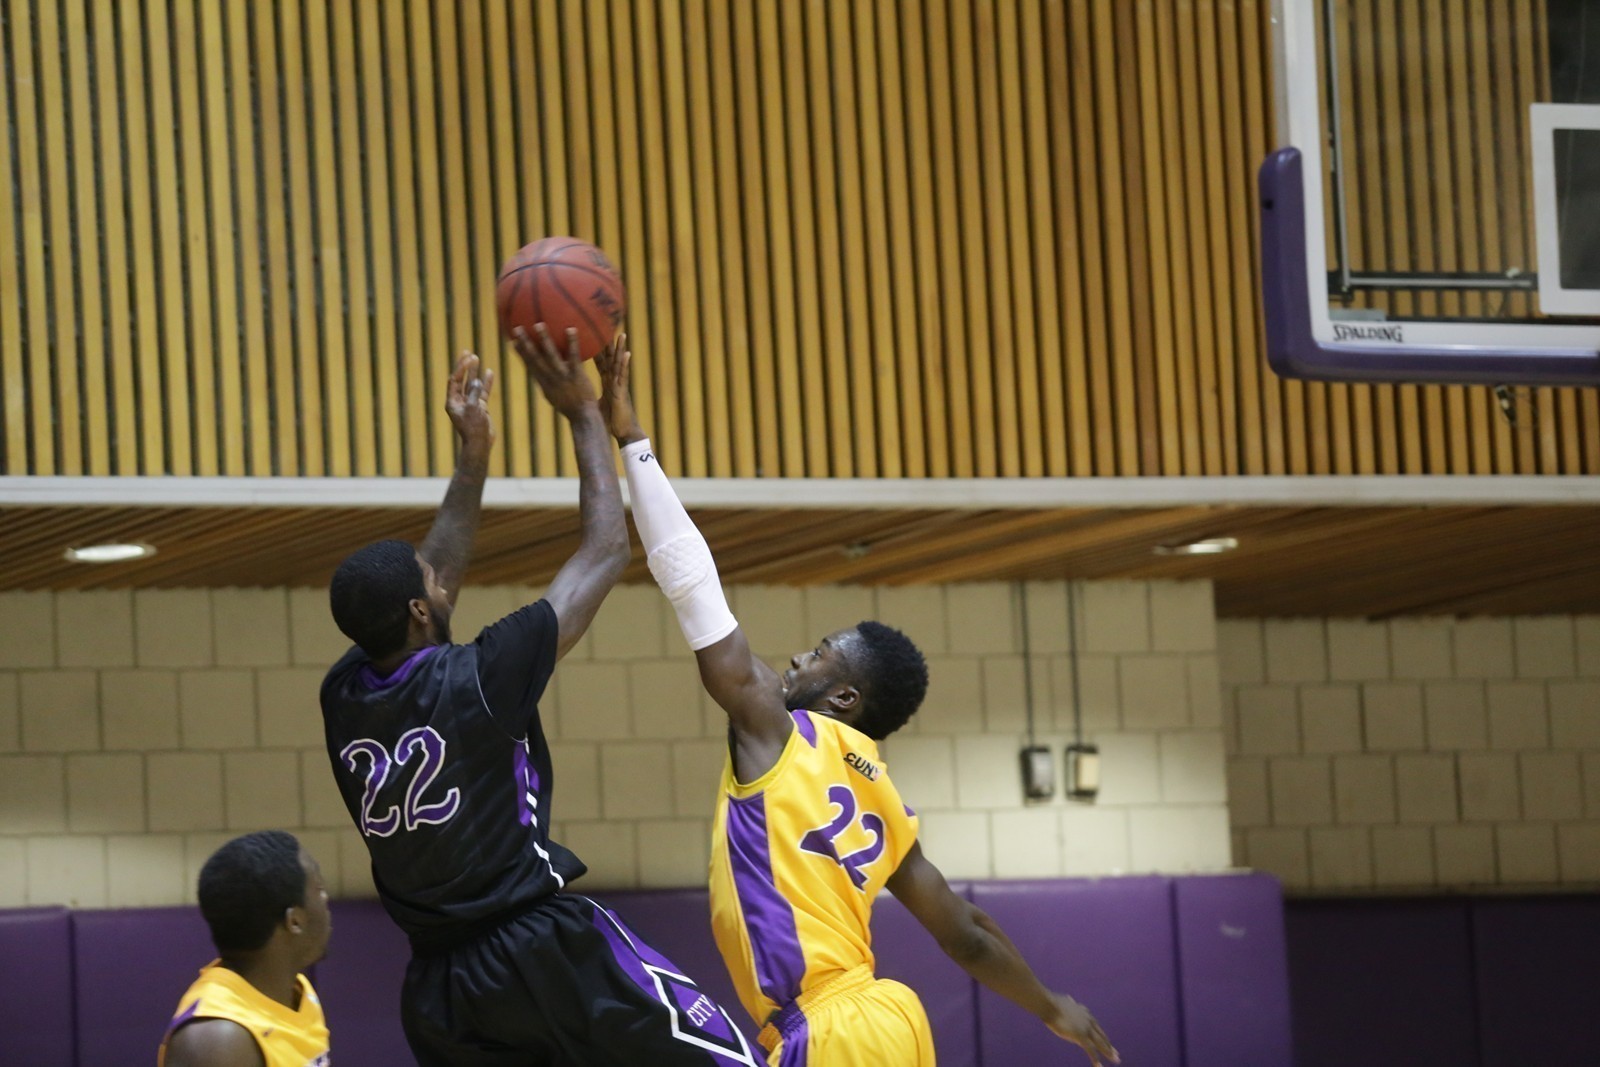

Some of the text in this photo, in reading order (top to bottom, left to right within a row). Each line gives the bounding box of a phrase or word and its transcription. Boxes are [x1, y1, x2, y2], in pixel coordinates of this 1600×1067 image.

[1333, 324, 1404, 343] SPALDING
[340, 725, 460, 837] 22
[799, 783, 886, 893] 22
[686, 993, 717, 1027] CITY
